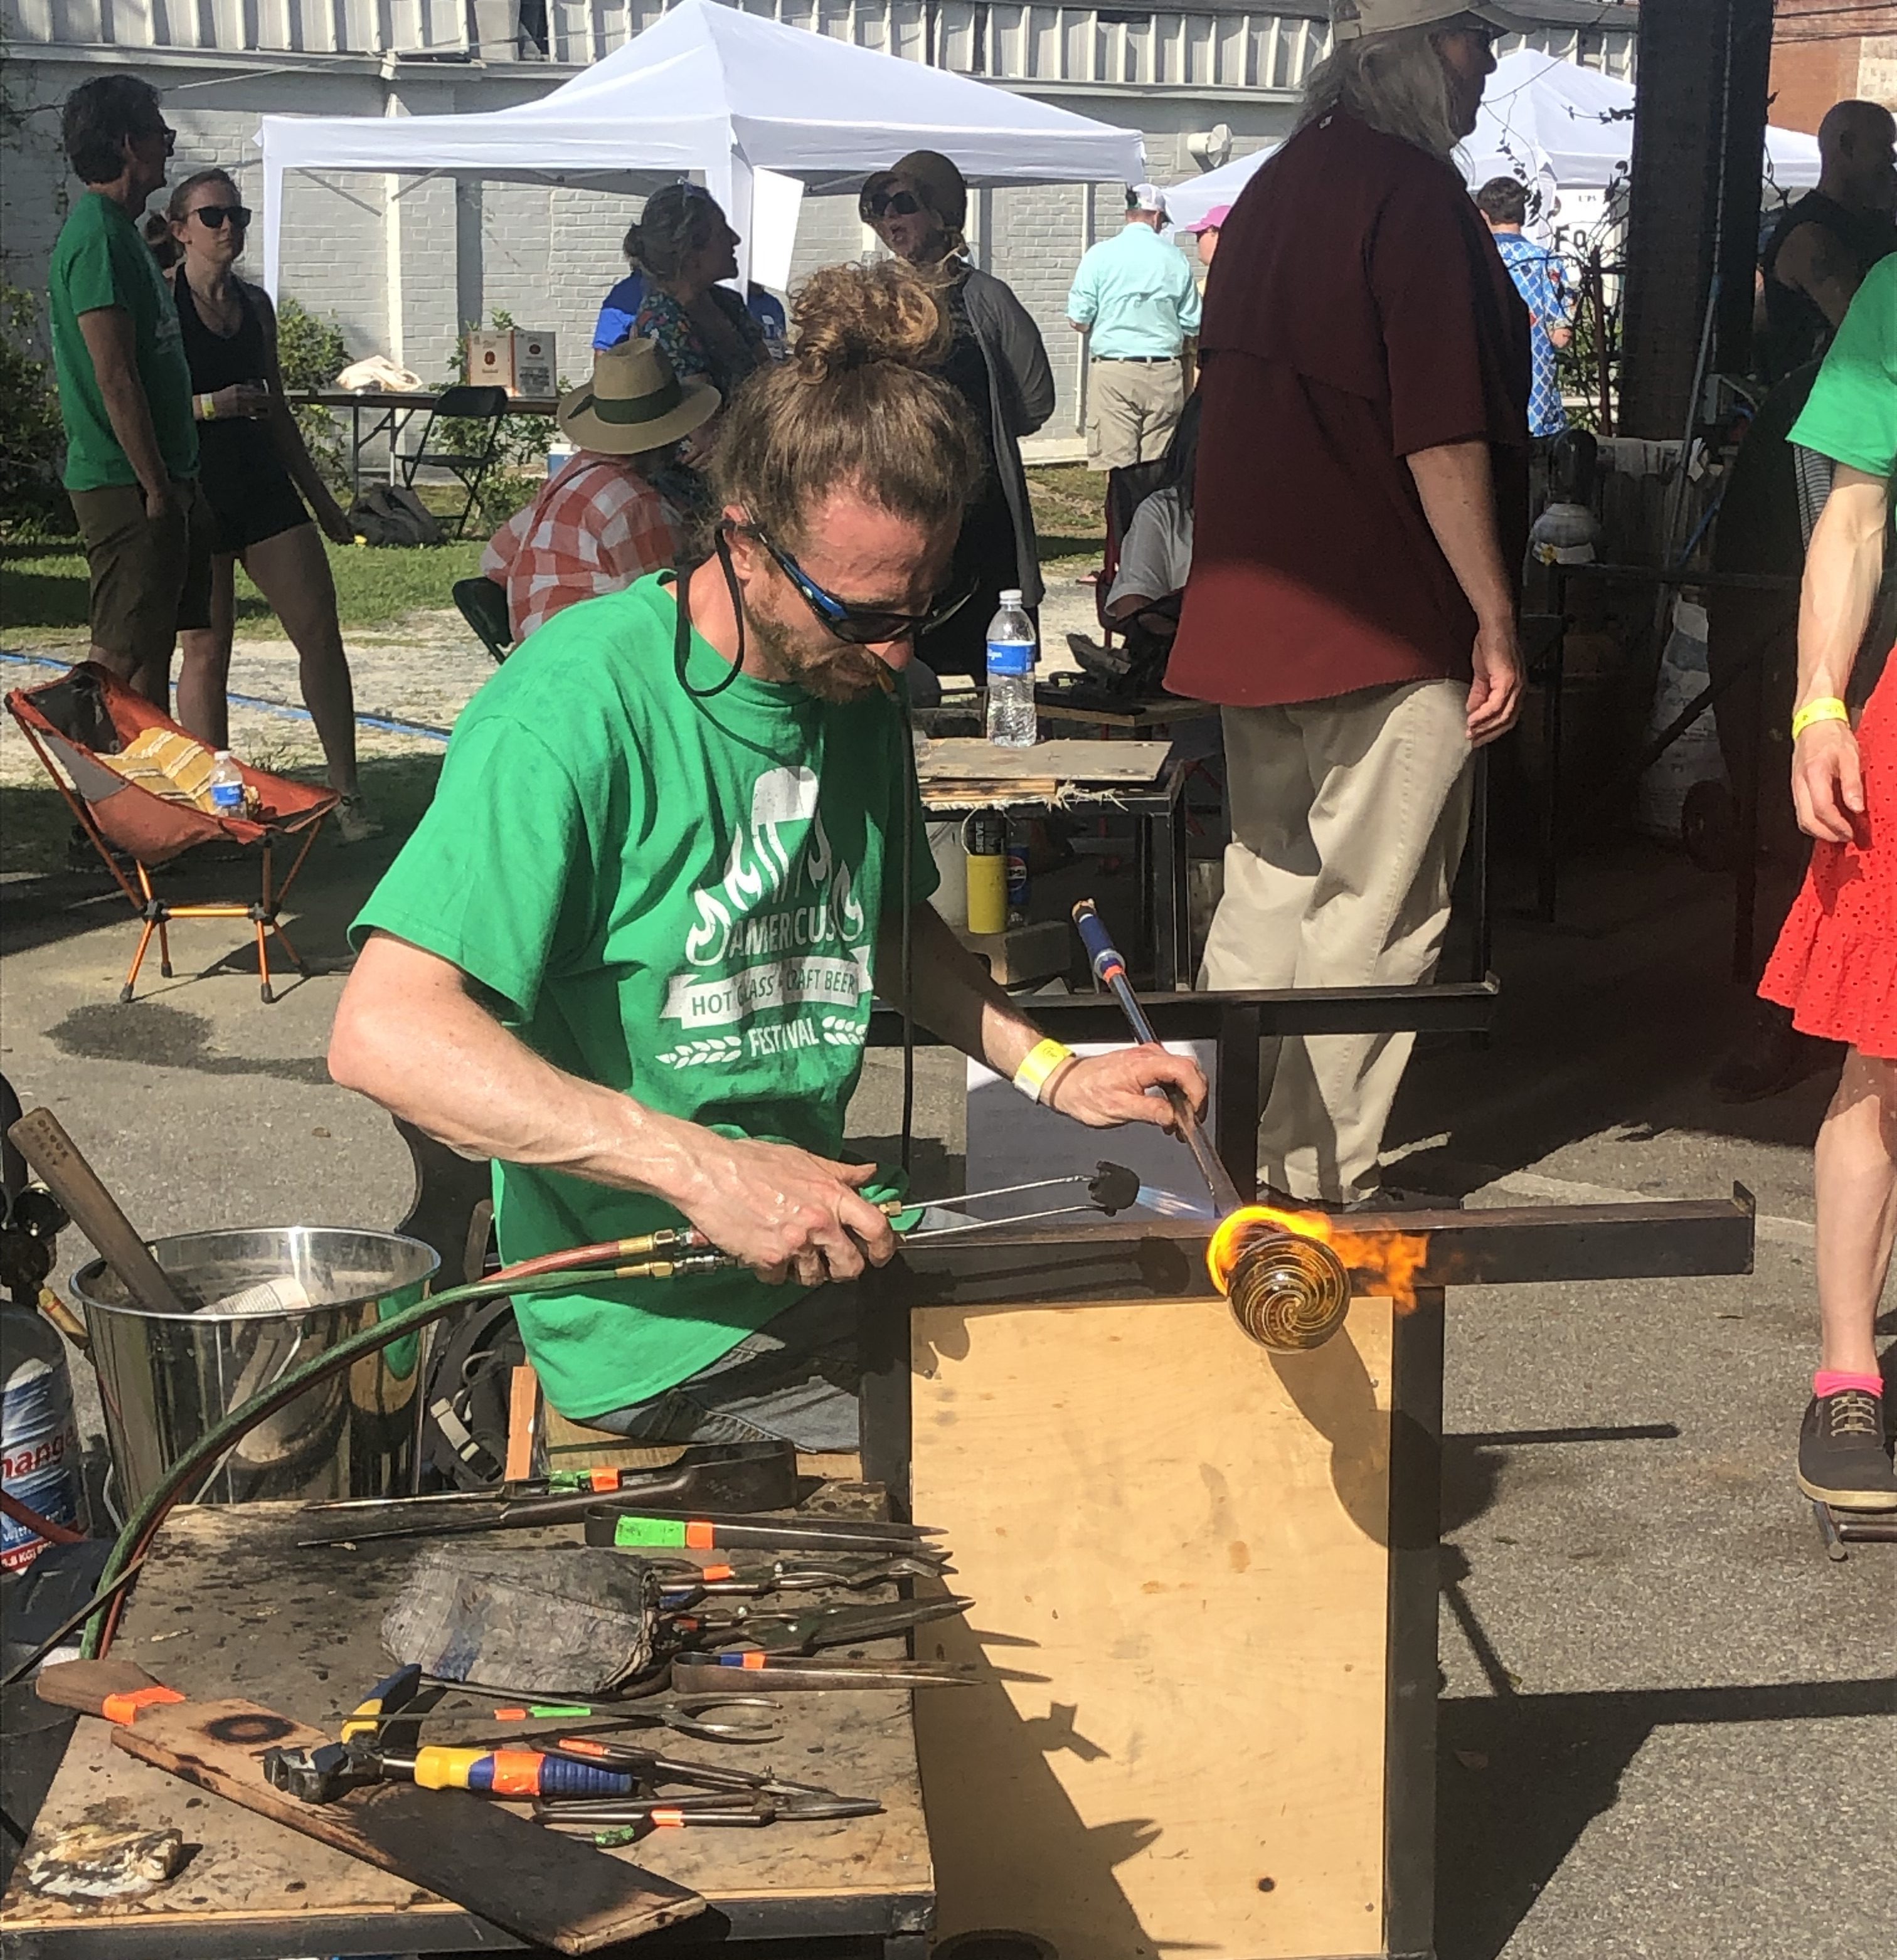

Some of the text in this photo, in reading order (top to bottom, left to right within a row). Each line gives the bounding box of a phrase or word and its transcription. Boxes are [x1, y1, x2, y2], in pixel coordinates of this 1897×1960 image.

[729, 905, 836, 959] AMERICUS
[692, 990, 731, 1016] HOT
[825, 970, 856, 995] BEER
[747, 1017, 820, 1057] FESTIVAL
